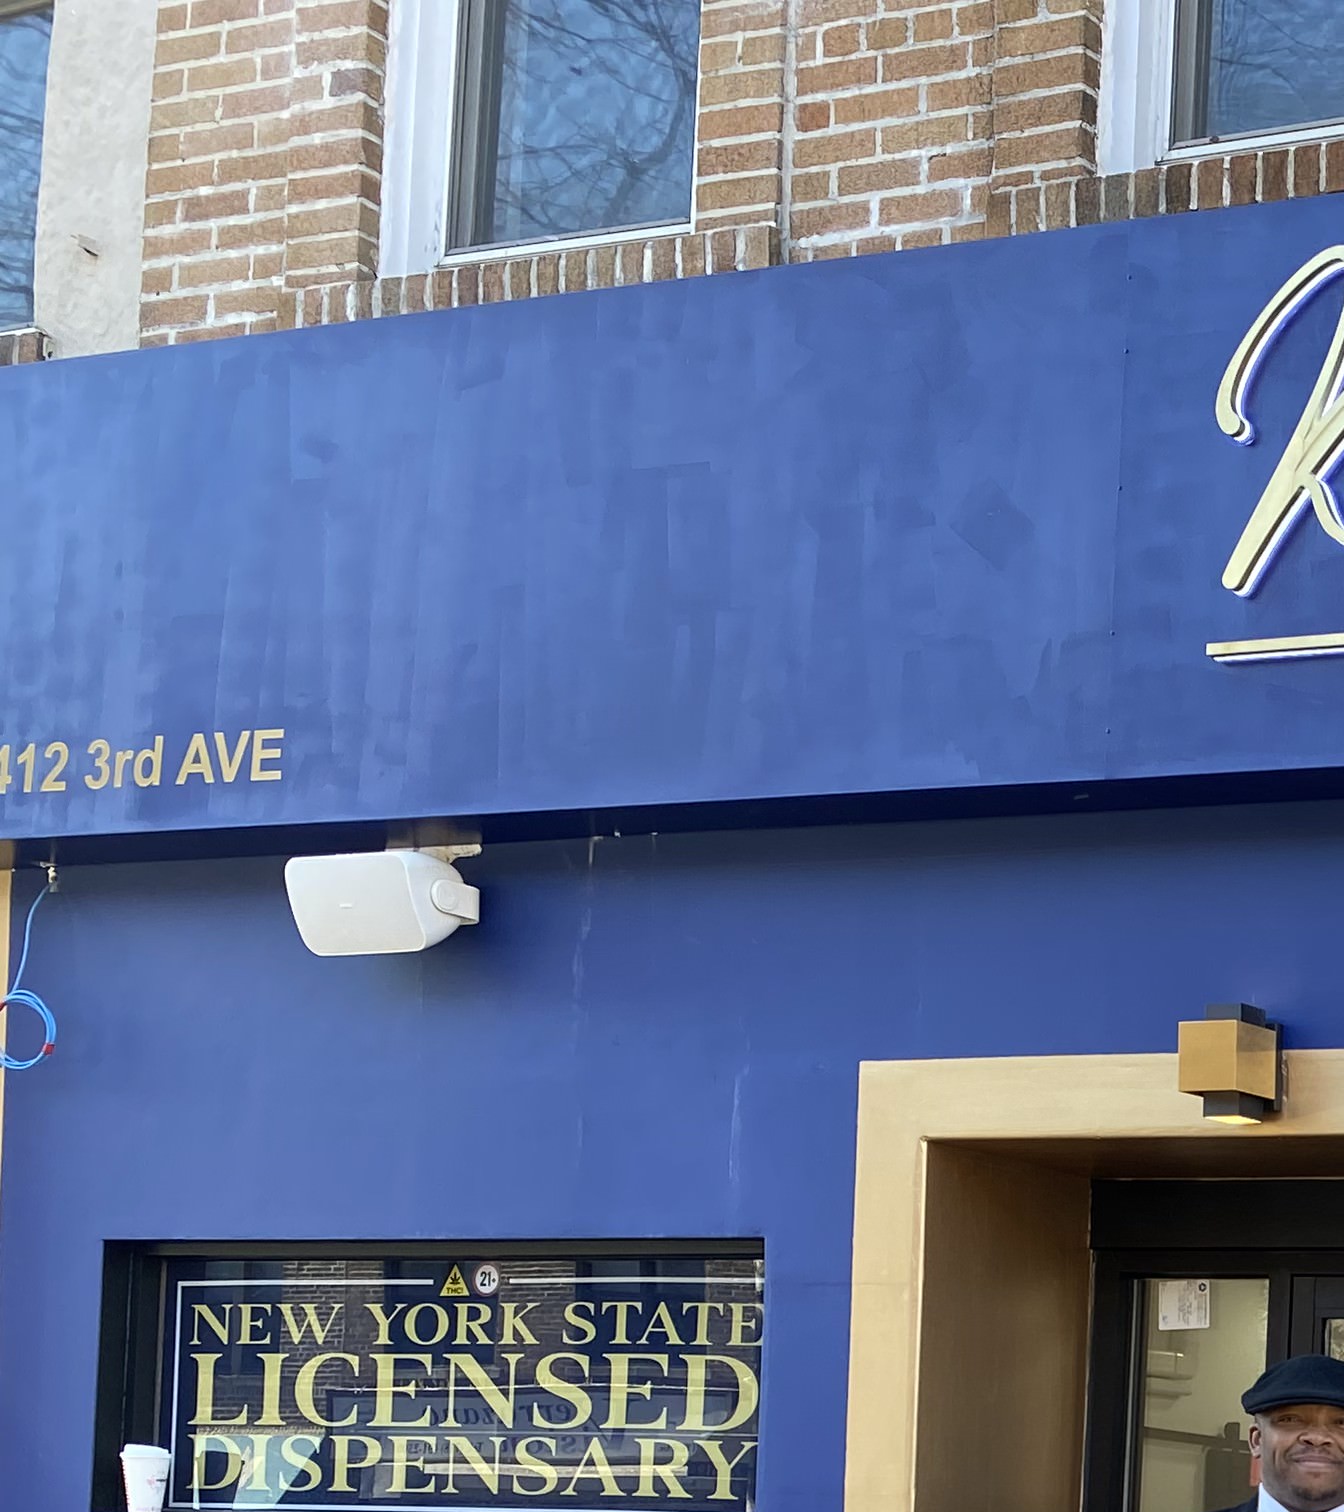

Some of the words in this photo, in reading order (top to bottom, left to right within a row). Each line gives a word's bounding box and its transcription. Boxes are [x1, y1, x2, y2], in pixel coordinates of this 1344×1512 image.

[84, 735, 164, 790] 3rd
[175, 729, 285, 785] AVE
[189, 1303, 344, 1346] NEW
[366, 1302, 538, 1346] YORK
[561, 1301, 764, 1346] STATE
[188, 1353, 759, 1431] LICENSED
[187, 1434, 759, 1500] DISPENSARY
